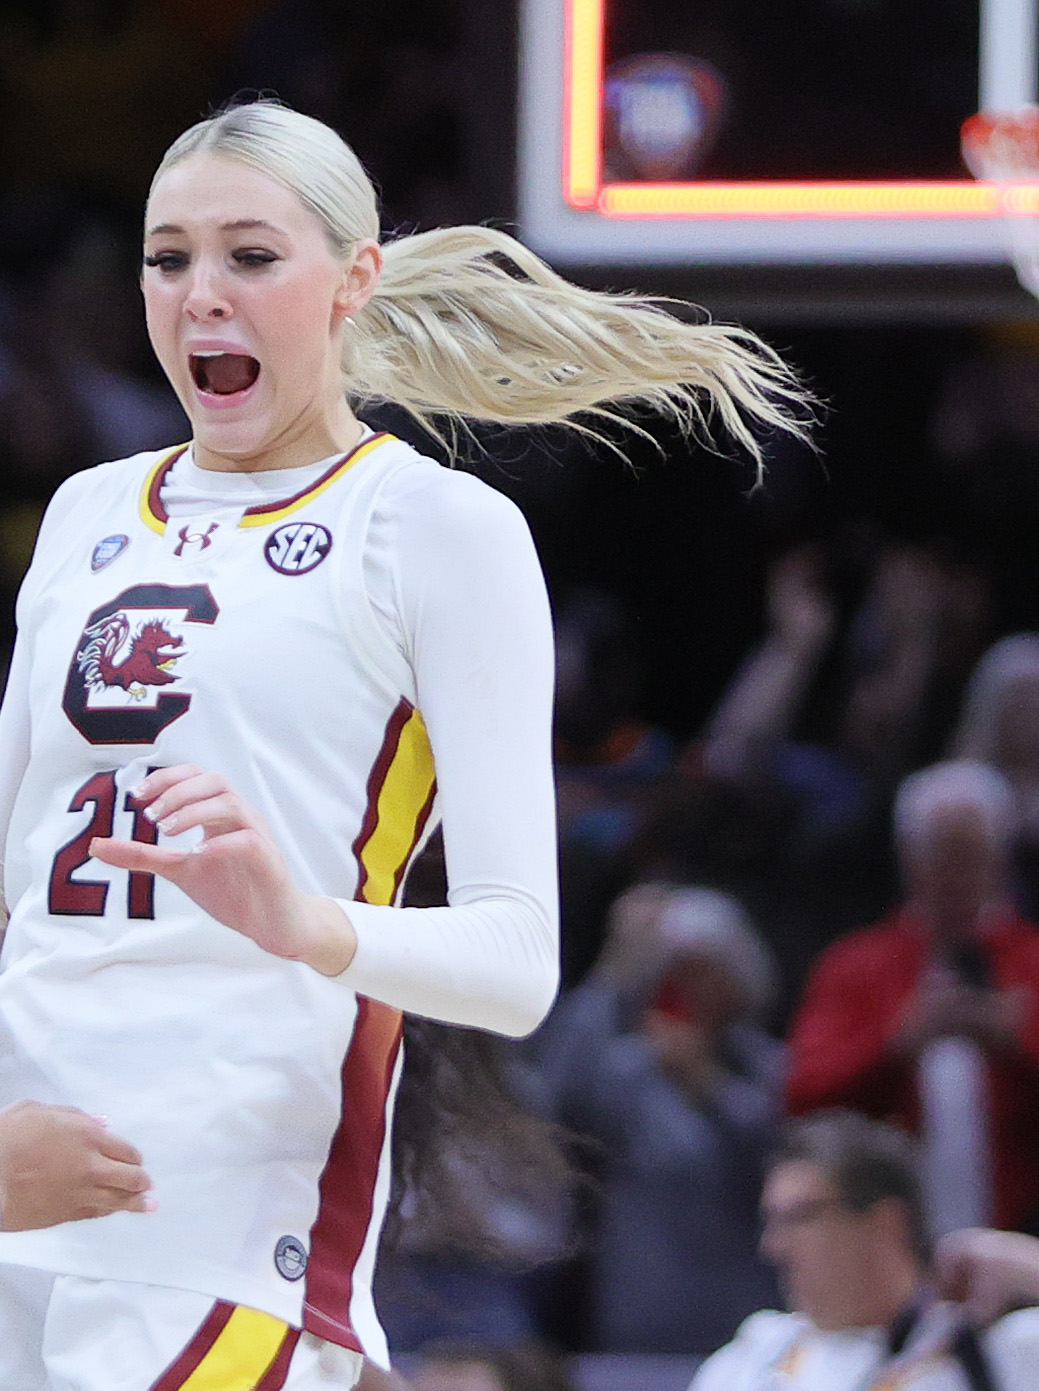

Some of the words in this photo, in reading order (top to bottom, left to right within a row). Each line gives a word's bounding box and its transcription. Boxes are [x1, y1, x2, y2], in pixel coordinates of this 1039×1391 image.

[268, 523, 330, 572] SEC
[62, 583, 219, 745] C
[48, 766, 163, 919] 21
